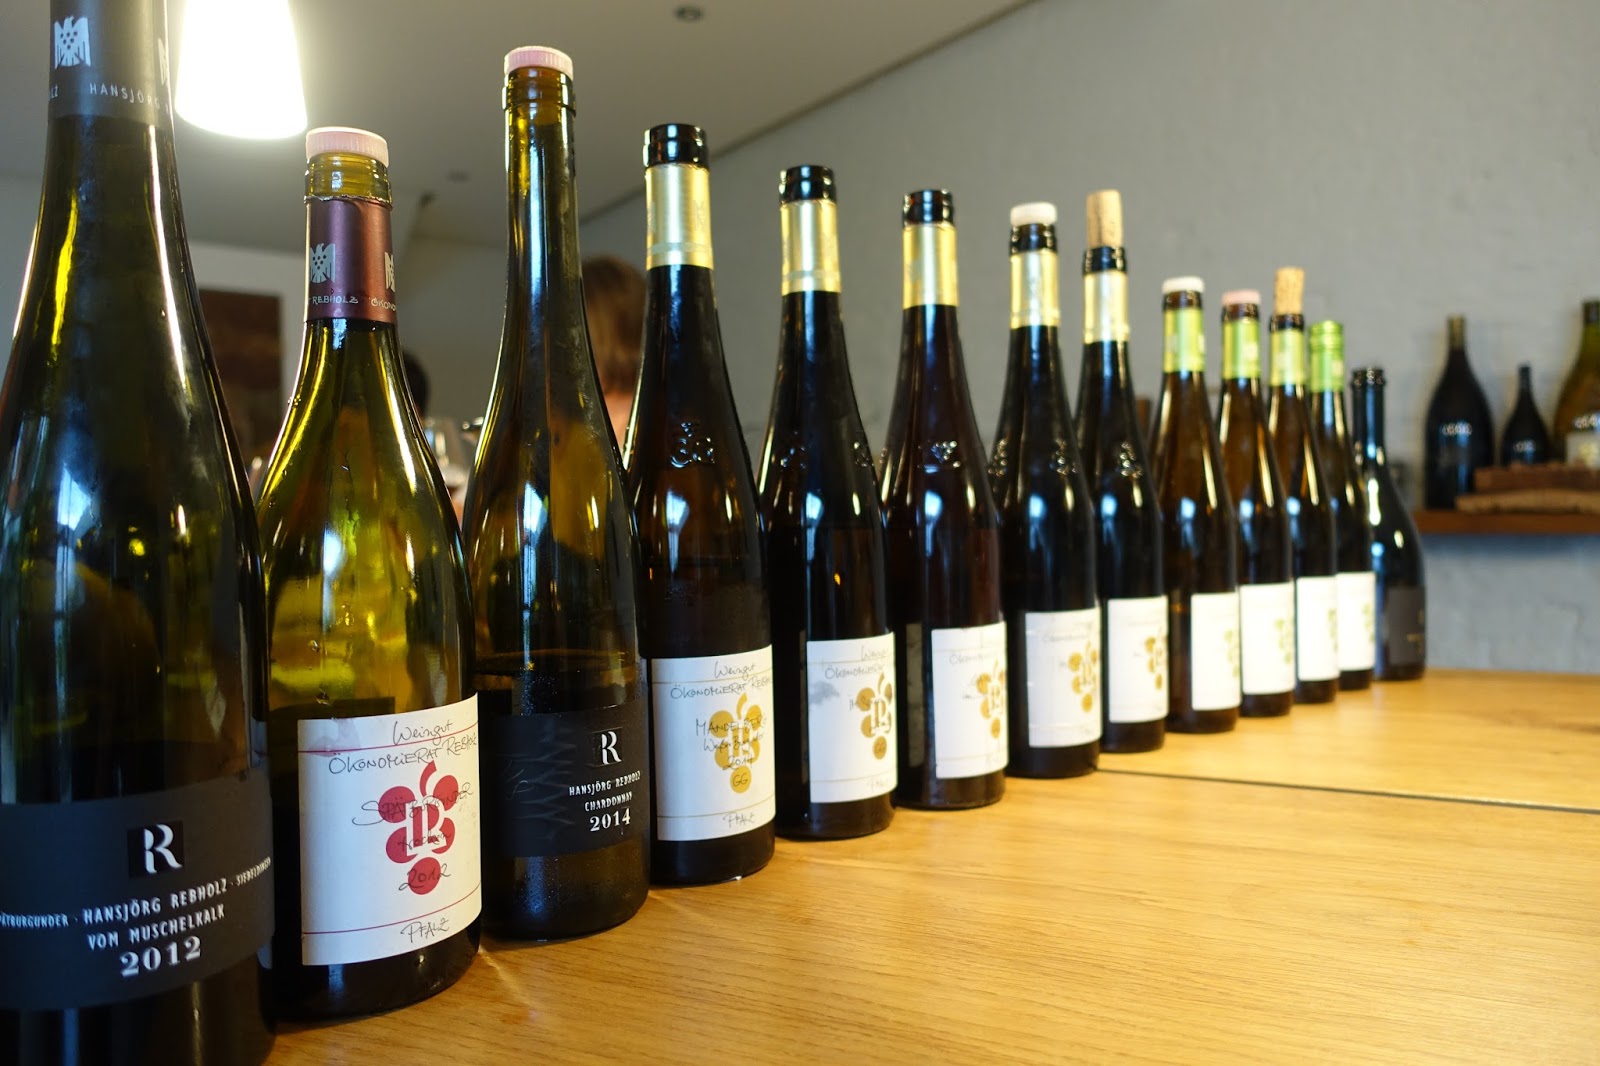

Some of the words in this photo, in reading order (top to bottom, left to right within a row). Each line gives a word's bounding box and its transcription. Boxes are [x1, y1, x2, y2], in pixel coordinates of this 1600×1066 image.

[312, 294, 359, 306] REBHOLZ
[670, 683, 748, 700] ÖKONOMIERAT
[392, 720, 454, 746] Weingut
[328, 747, 442, 775] ÖKONOMIERAT
[600, 730, 622, 765] R
[569, 780, 612, 797] HANSJÖRG
[615, 770, 641, 788] REBHOLZ
[584, 791, 633, 812] CHARDONNAY
[589, 807, 631, 832] 2014
[143, 823, 183, 874] R
[398, 863, 451, 892] 2012
[0, 911, 69, 929] ÄTBURGUNDER
[82, 898, 162, 924] HANSJÖRG
[170, 877, 228, 909] REBHOLZ
[128, 903, 226, 944] MUSCHELKALK
[400, 917, 450, 943] PFALZ
[119, 935, 202, 977] 2012
